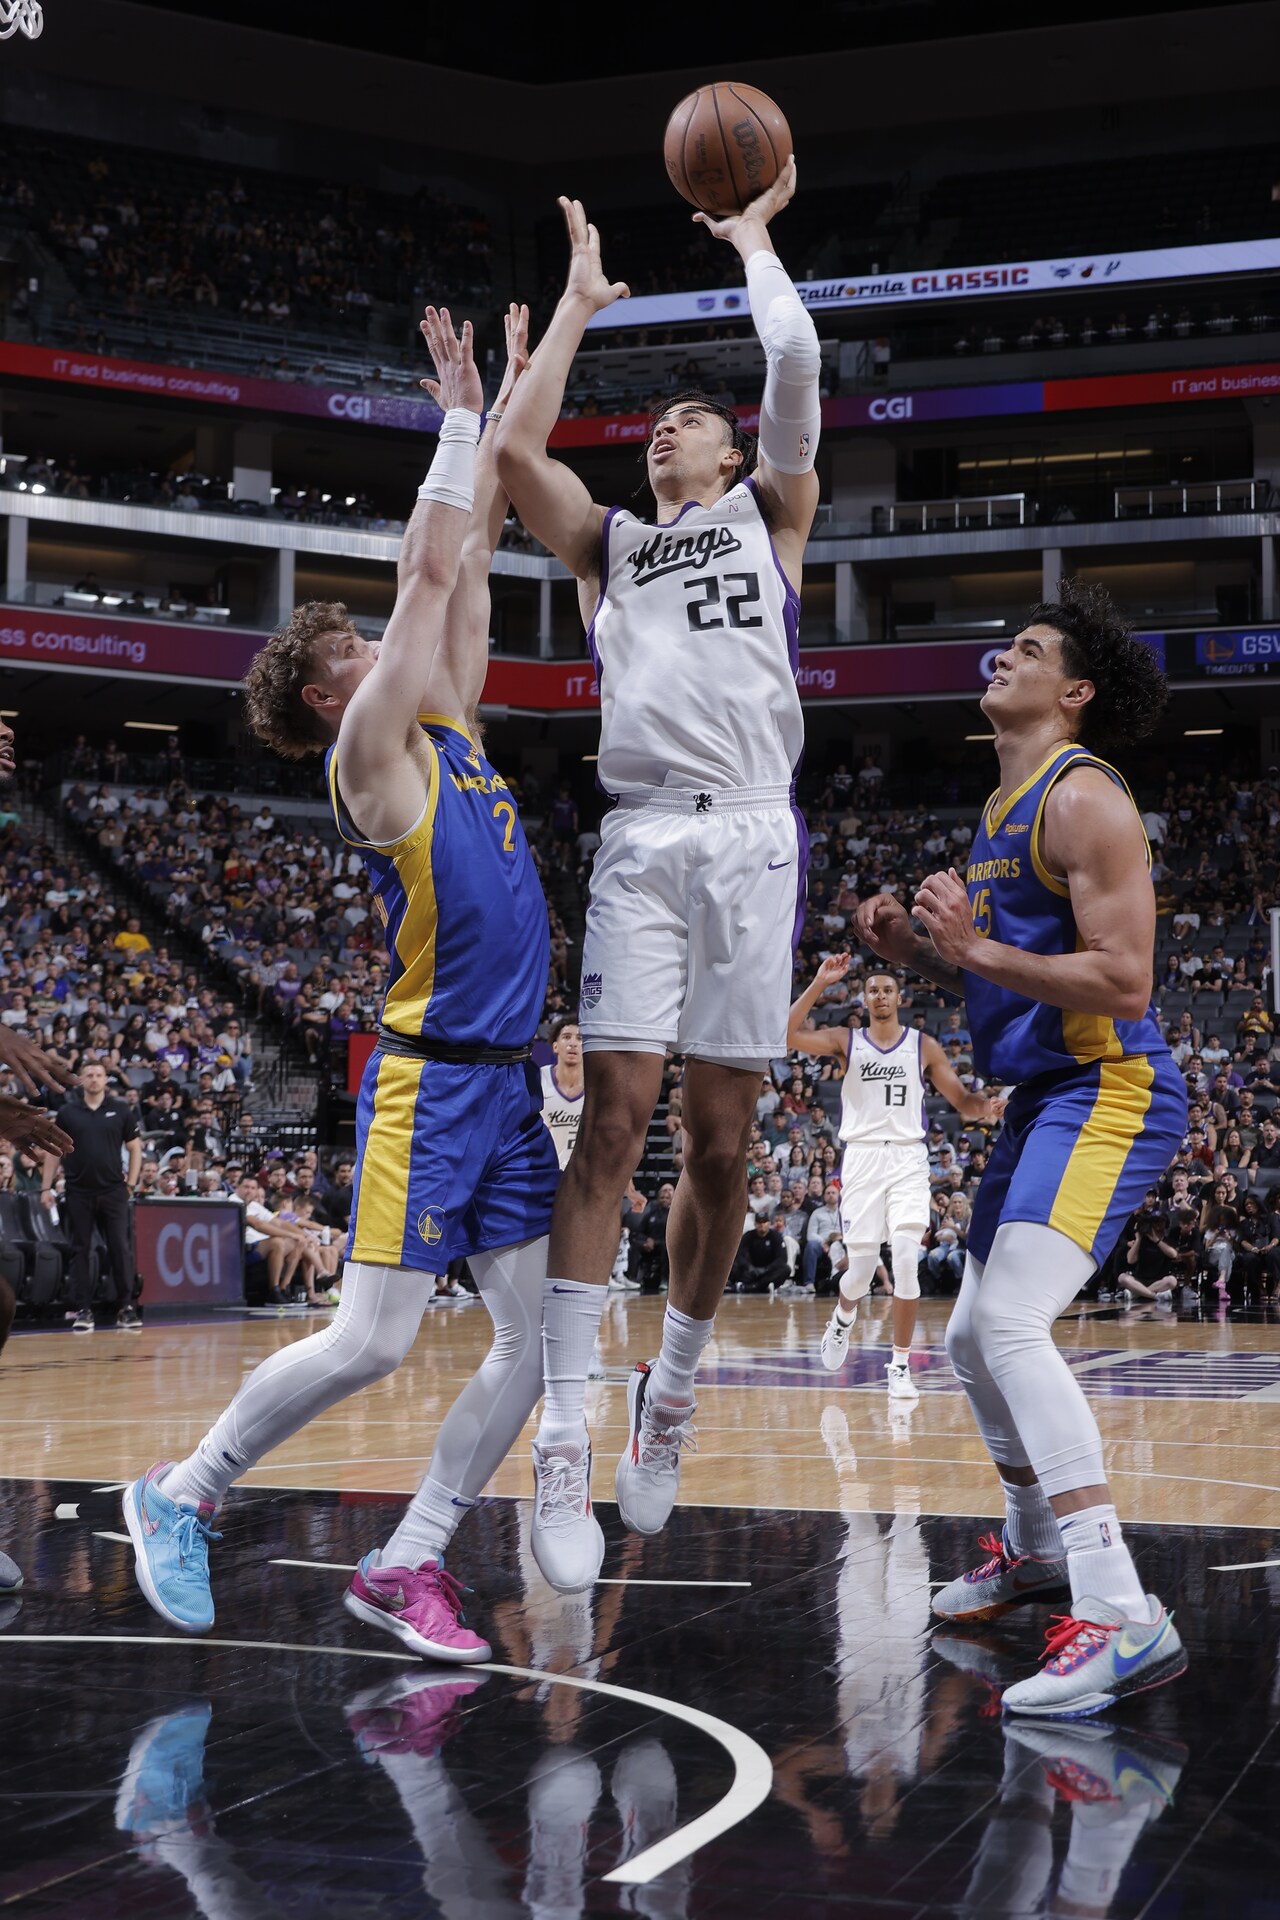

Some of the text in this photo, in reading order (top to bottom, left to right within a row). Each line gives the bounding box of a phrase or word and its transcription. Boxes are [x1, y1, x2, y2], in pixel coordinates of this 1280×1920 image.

[732, 118, 766, 192] Wilso
[911, 268, 1029, 294] CLASSIC
[53, 359, 240, 400] IT and business consulting
[1172, 379, 1187, 394] IT
[1188, 377, 1217, 393] and
[327, 393, 371, 420] CGI
[868, 396, 913, 421] CGI
[604, 424, 620, 437] IT
[627, 527, 742, 587] Kings
[683, 572, 763, 632] 22
[31, 630, 146, 663] consulting
[566, 676, 587, 697] IT
[493, 801, 515, 852] 2
[1005, 823, 1030, 835] Rakuten
[860, 1062, 907, 1082] Kings
[884, 1084, 907, 1106] 13
[548, 1110, 581, 1127] King
[156, 1222, 221, 1287] CGI
